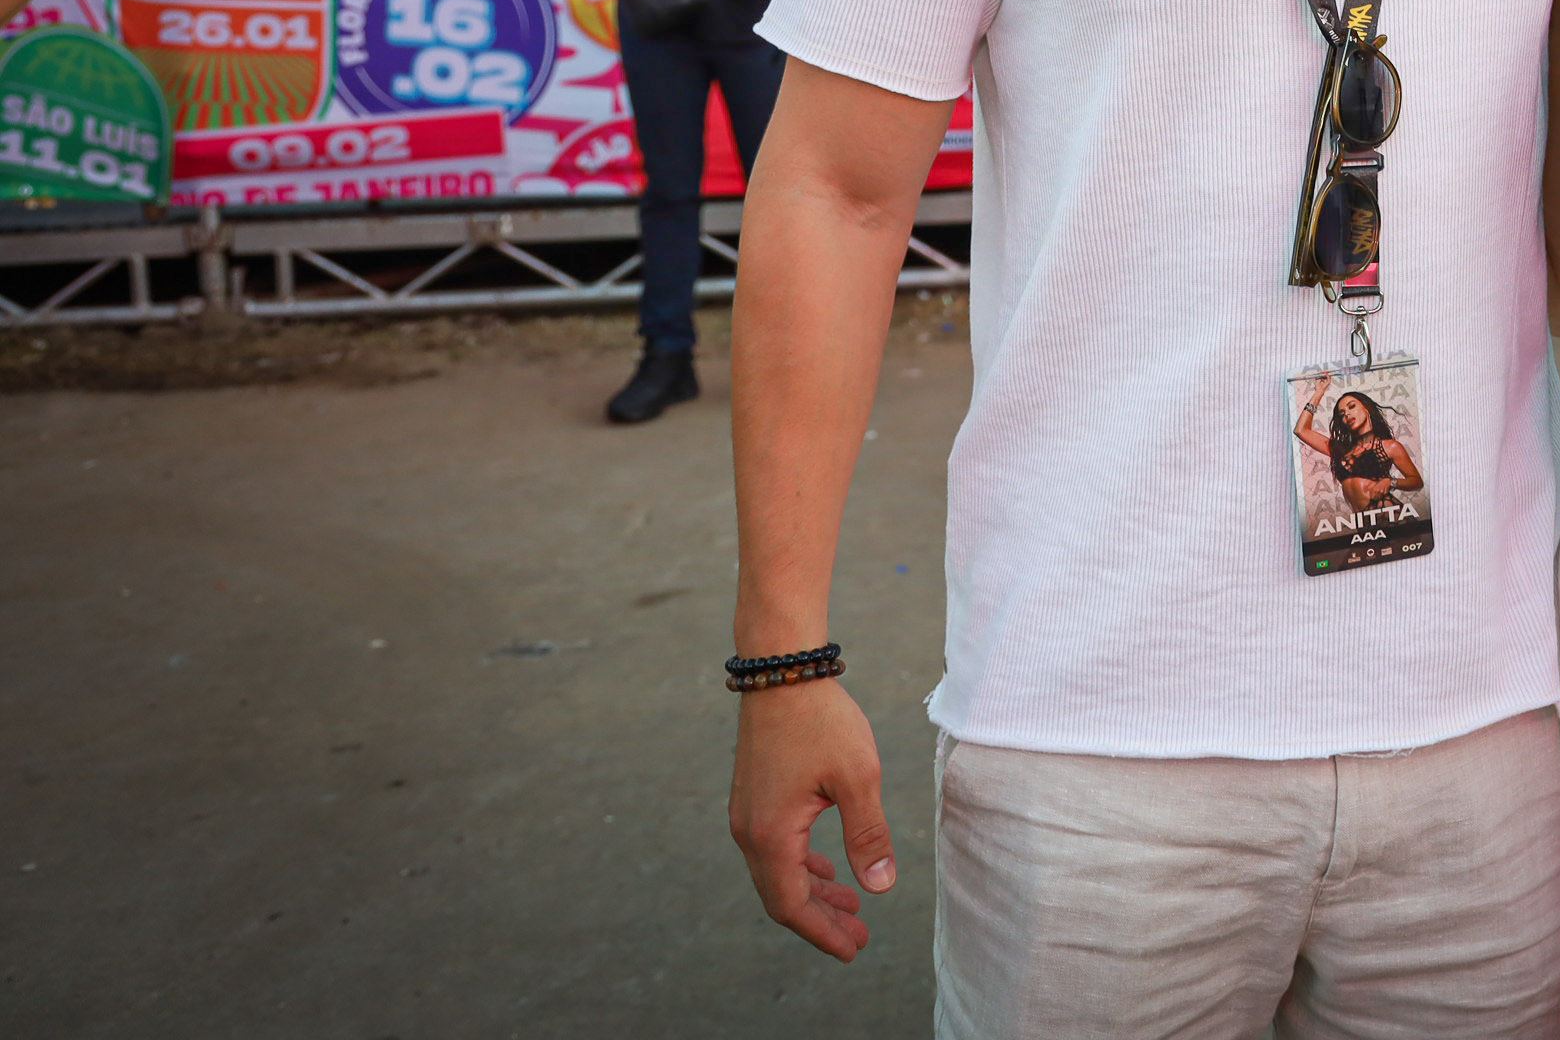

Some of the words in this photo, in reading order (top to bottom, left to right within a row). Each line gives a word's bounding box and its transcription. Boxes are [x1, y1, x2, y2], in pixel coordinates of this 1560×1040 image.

[158, 10, 318, 50] 26.01
[393, 47, 528, 103] .02
[2, 93, 74, 137] SÃO
[0, 130, 155, 198] 11.01
[228, 126, 411, 171] 09.02
[1314, 503, 1420, 537] ANITTA
[1350, 529, 1387, 545] AAA
[1401, 542, 1423, 553] 007
